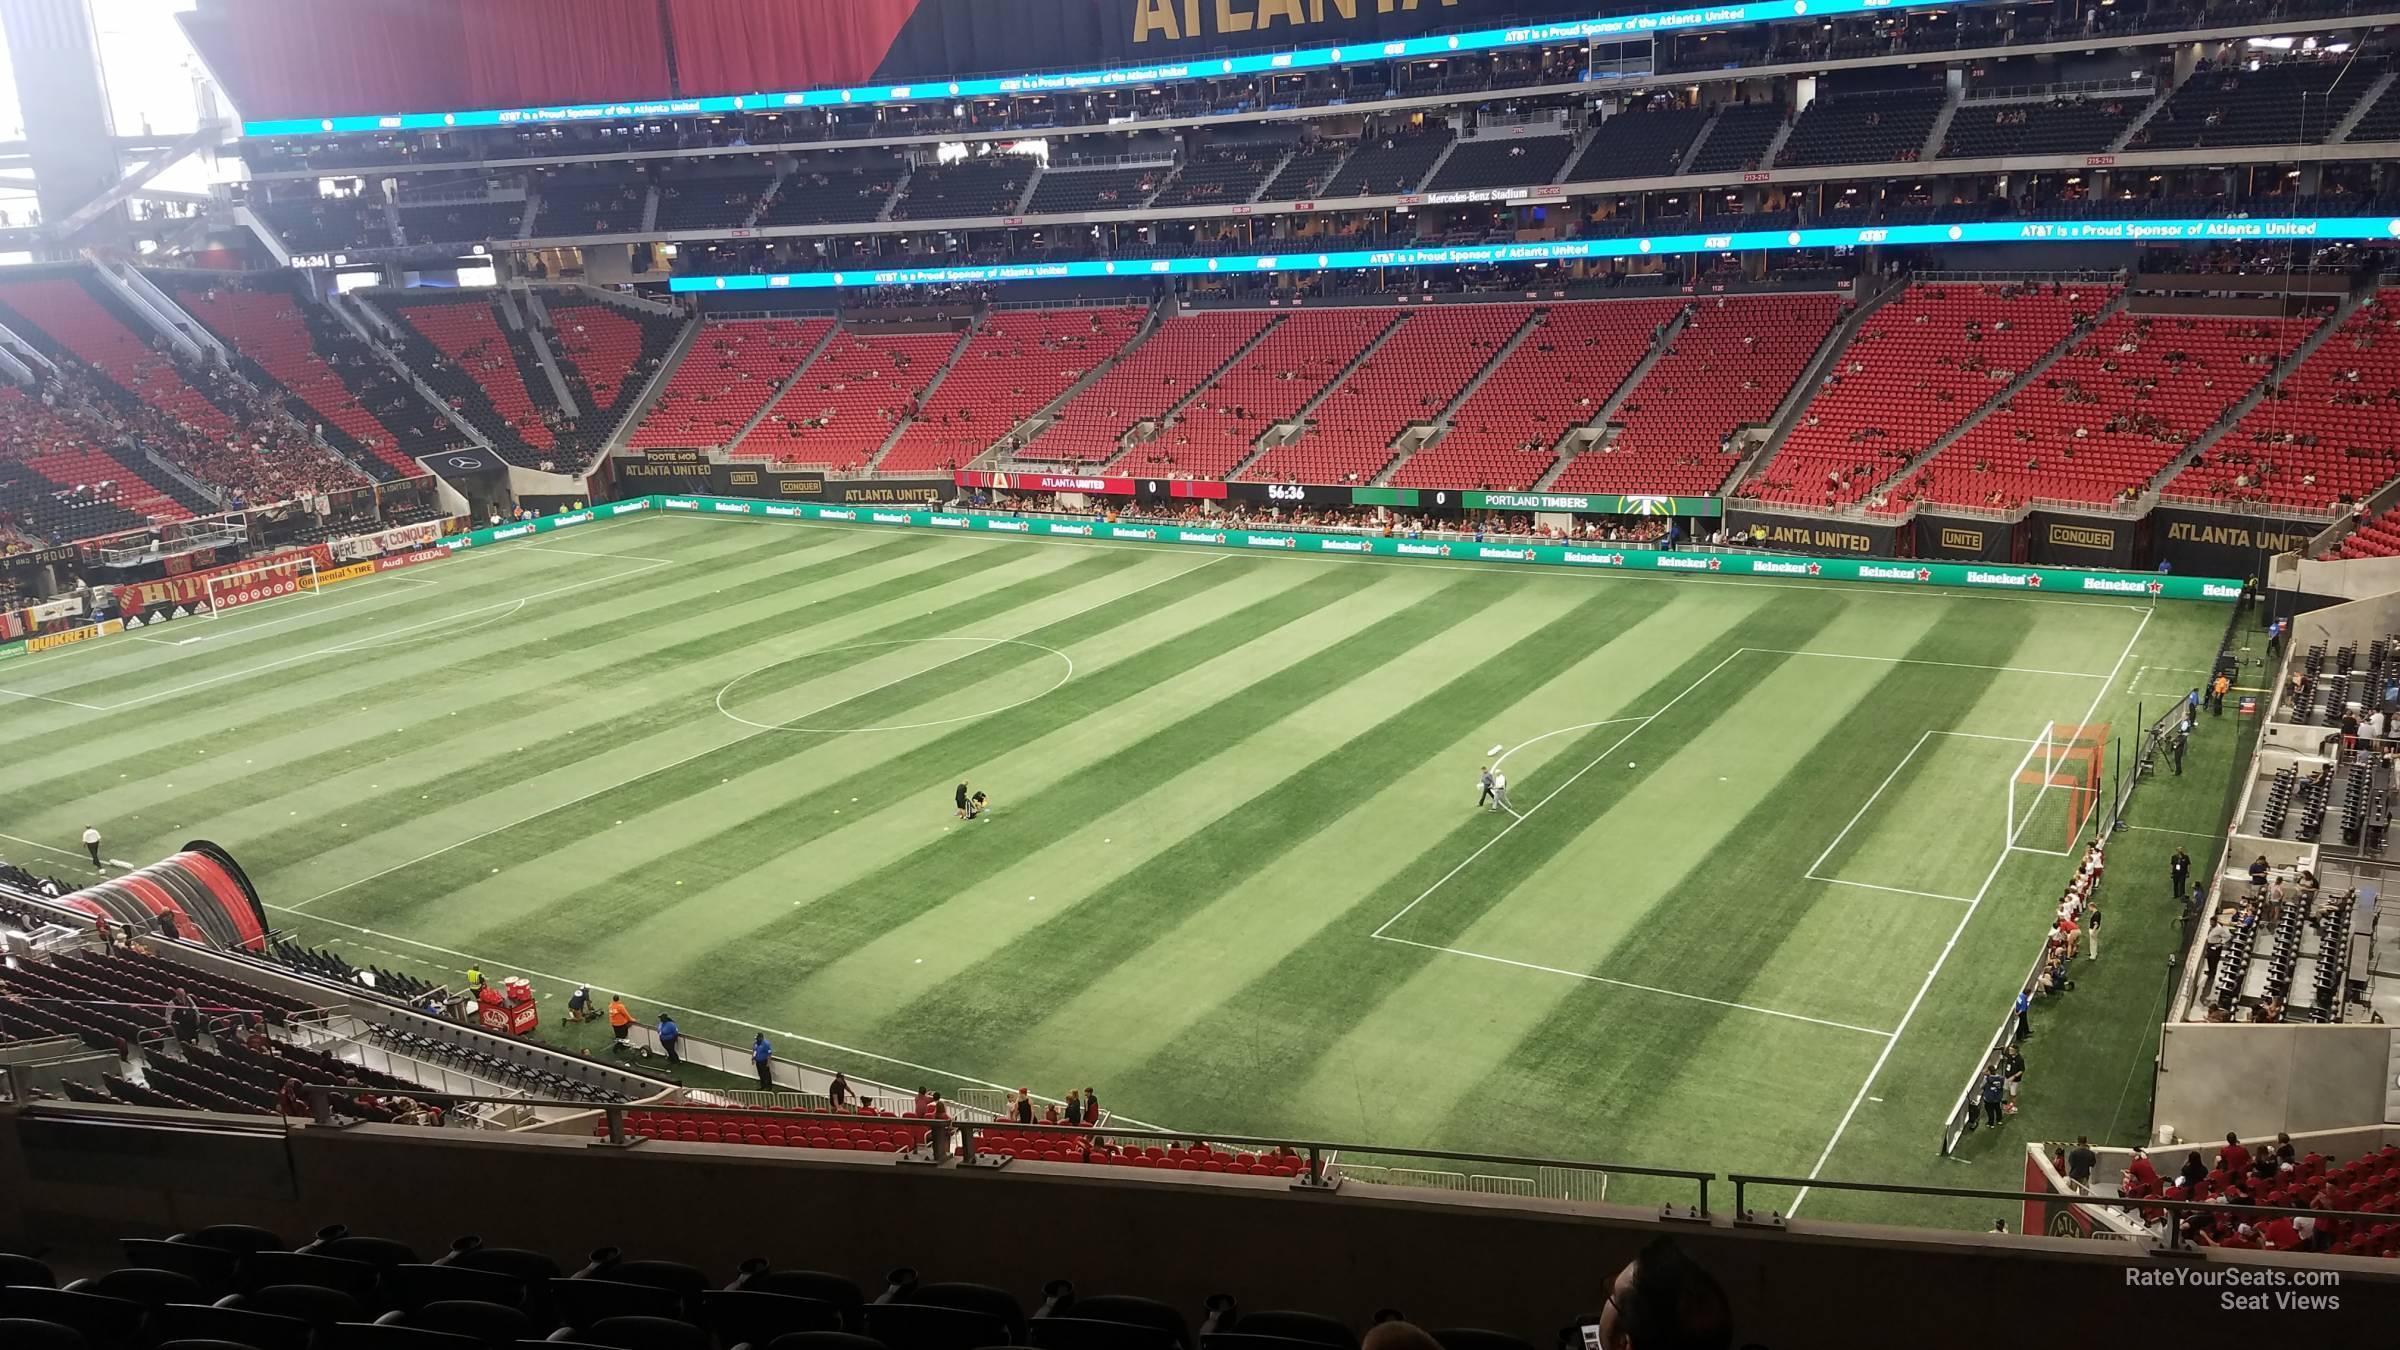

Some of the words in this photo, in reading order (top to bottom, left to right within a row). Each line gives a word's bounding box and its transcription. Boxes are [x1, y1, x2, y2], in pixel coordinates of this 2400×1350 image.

[1505, 30, 1531, 42] AT&T
[1549, 25, 1580, 36] Proud
[1581, 21, 1623, 35] Sponsor
[1658, 13, 1701, 26] Atlanta
[1705, 9, 1744, 21] United
[1428, 192, 1490, 204] Mercedes-Benz
[1491, 188, 1528, 200] Stadium
[1858, 230, 1888, 243] AT&T
[2021, 225, 2053, 237] AT&T
[2057, 225, 2067, 236] is
[2071, 228, 2078, 236] a
[2083, 224, 2122, 236] Proud
[2127, 223, 2183, 238] Sponsor
[2188, 223, 2203, 235] of
[2206, 222, 2261, 235] Atlanta
[2266, 222, 2317, 235] United
[1704, 236, 1732, 248] AT&T
[1370, 253, 1396, 264] AT&T
[1398, 252, 1406, 263] is
[1417, 251, 1447, 262] Proud
[1449, 249, 1491, 262] Sponsor
[1495, 247, 1507, 258] of
[1509, 247, 1549, 258] Atlanta
[1552, 244, 1589, 256] United
[291, 255, 325, 268] 56:36
[648, 452, 677, 461] FOOTIE
[678, 452, 697, 461] MOB
[626, 465, 671, 476] ATLANTA
[672, 464, 711, 475] UNITED
[733, 474, 756, 482] UNITE
[1041, 477, 1075, 488] ATLANTA
[1076, 478, 1104, 490] UNITED
[783, 482, 820, 492] CONQUER
[1149, 481, 1156, 493] 0
[1268, 485, 1305, 501] 56:36
[845, 489, 893, 502] ATLANTA
[896, 488, 938, 501] UNITED
[1436, 491, 1445, 504] 0
[1485, 495, 1539, 506] PORTLAND
[1540, 496, 1588, 508] TIMBERS
[361, 539, 373, 553] TO
[390, 525, 437, 546] CONQUER
[1180, 531, 1216, 543] Heineken
[1248, 535, 1286, 546] Heineken
[1750, 524, 1811, 545] ALANTA
[1815, 530, 1870, 552] UNITED
[1946, 532, 1979, 547] UNITE
[2053, 529, 2111, 545] CONQUER
[2168, 522, 2250, 547] ATLANTA
[2256, 531, 2313, 552] UNIT
[1322, 539, 1362, 551] Heineken
[1397, 543, 1439, 555] Heineken
[35, 547, 74, 564] PROUD
[1480, 547, 1524, 559] Heineken
[1564, 551, 1611, 564] Heineken
[382, 557, 404, 569] Audi
[1657, 556, 1707, 569] Heineken
[1753, 560, 1806, 574] Heineken
[298, 569, 346, 589] Continental
[354, 564, 372, 575] TIRE
[1859, 565, 1916, 579] Heineken
[1967, 571, 2026, 585] Heineken
[2084, 577, 2146, 592] Heineken
[2203, 583, 2242, 597] Heine
[28, 627, 98, 653] QUIKRETE
